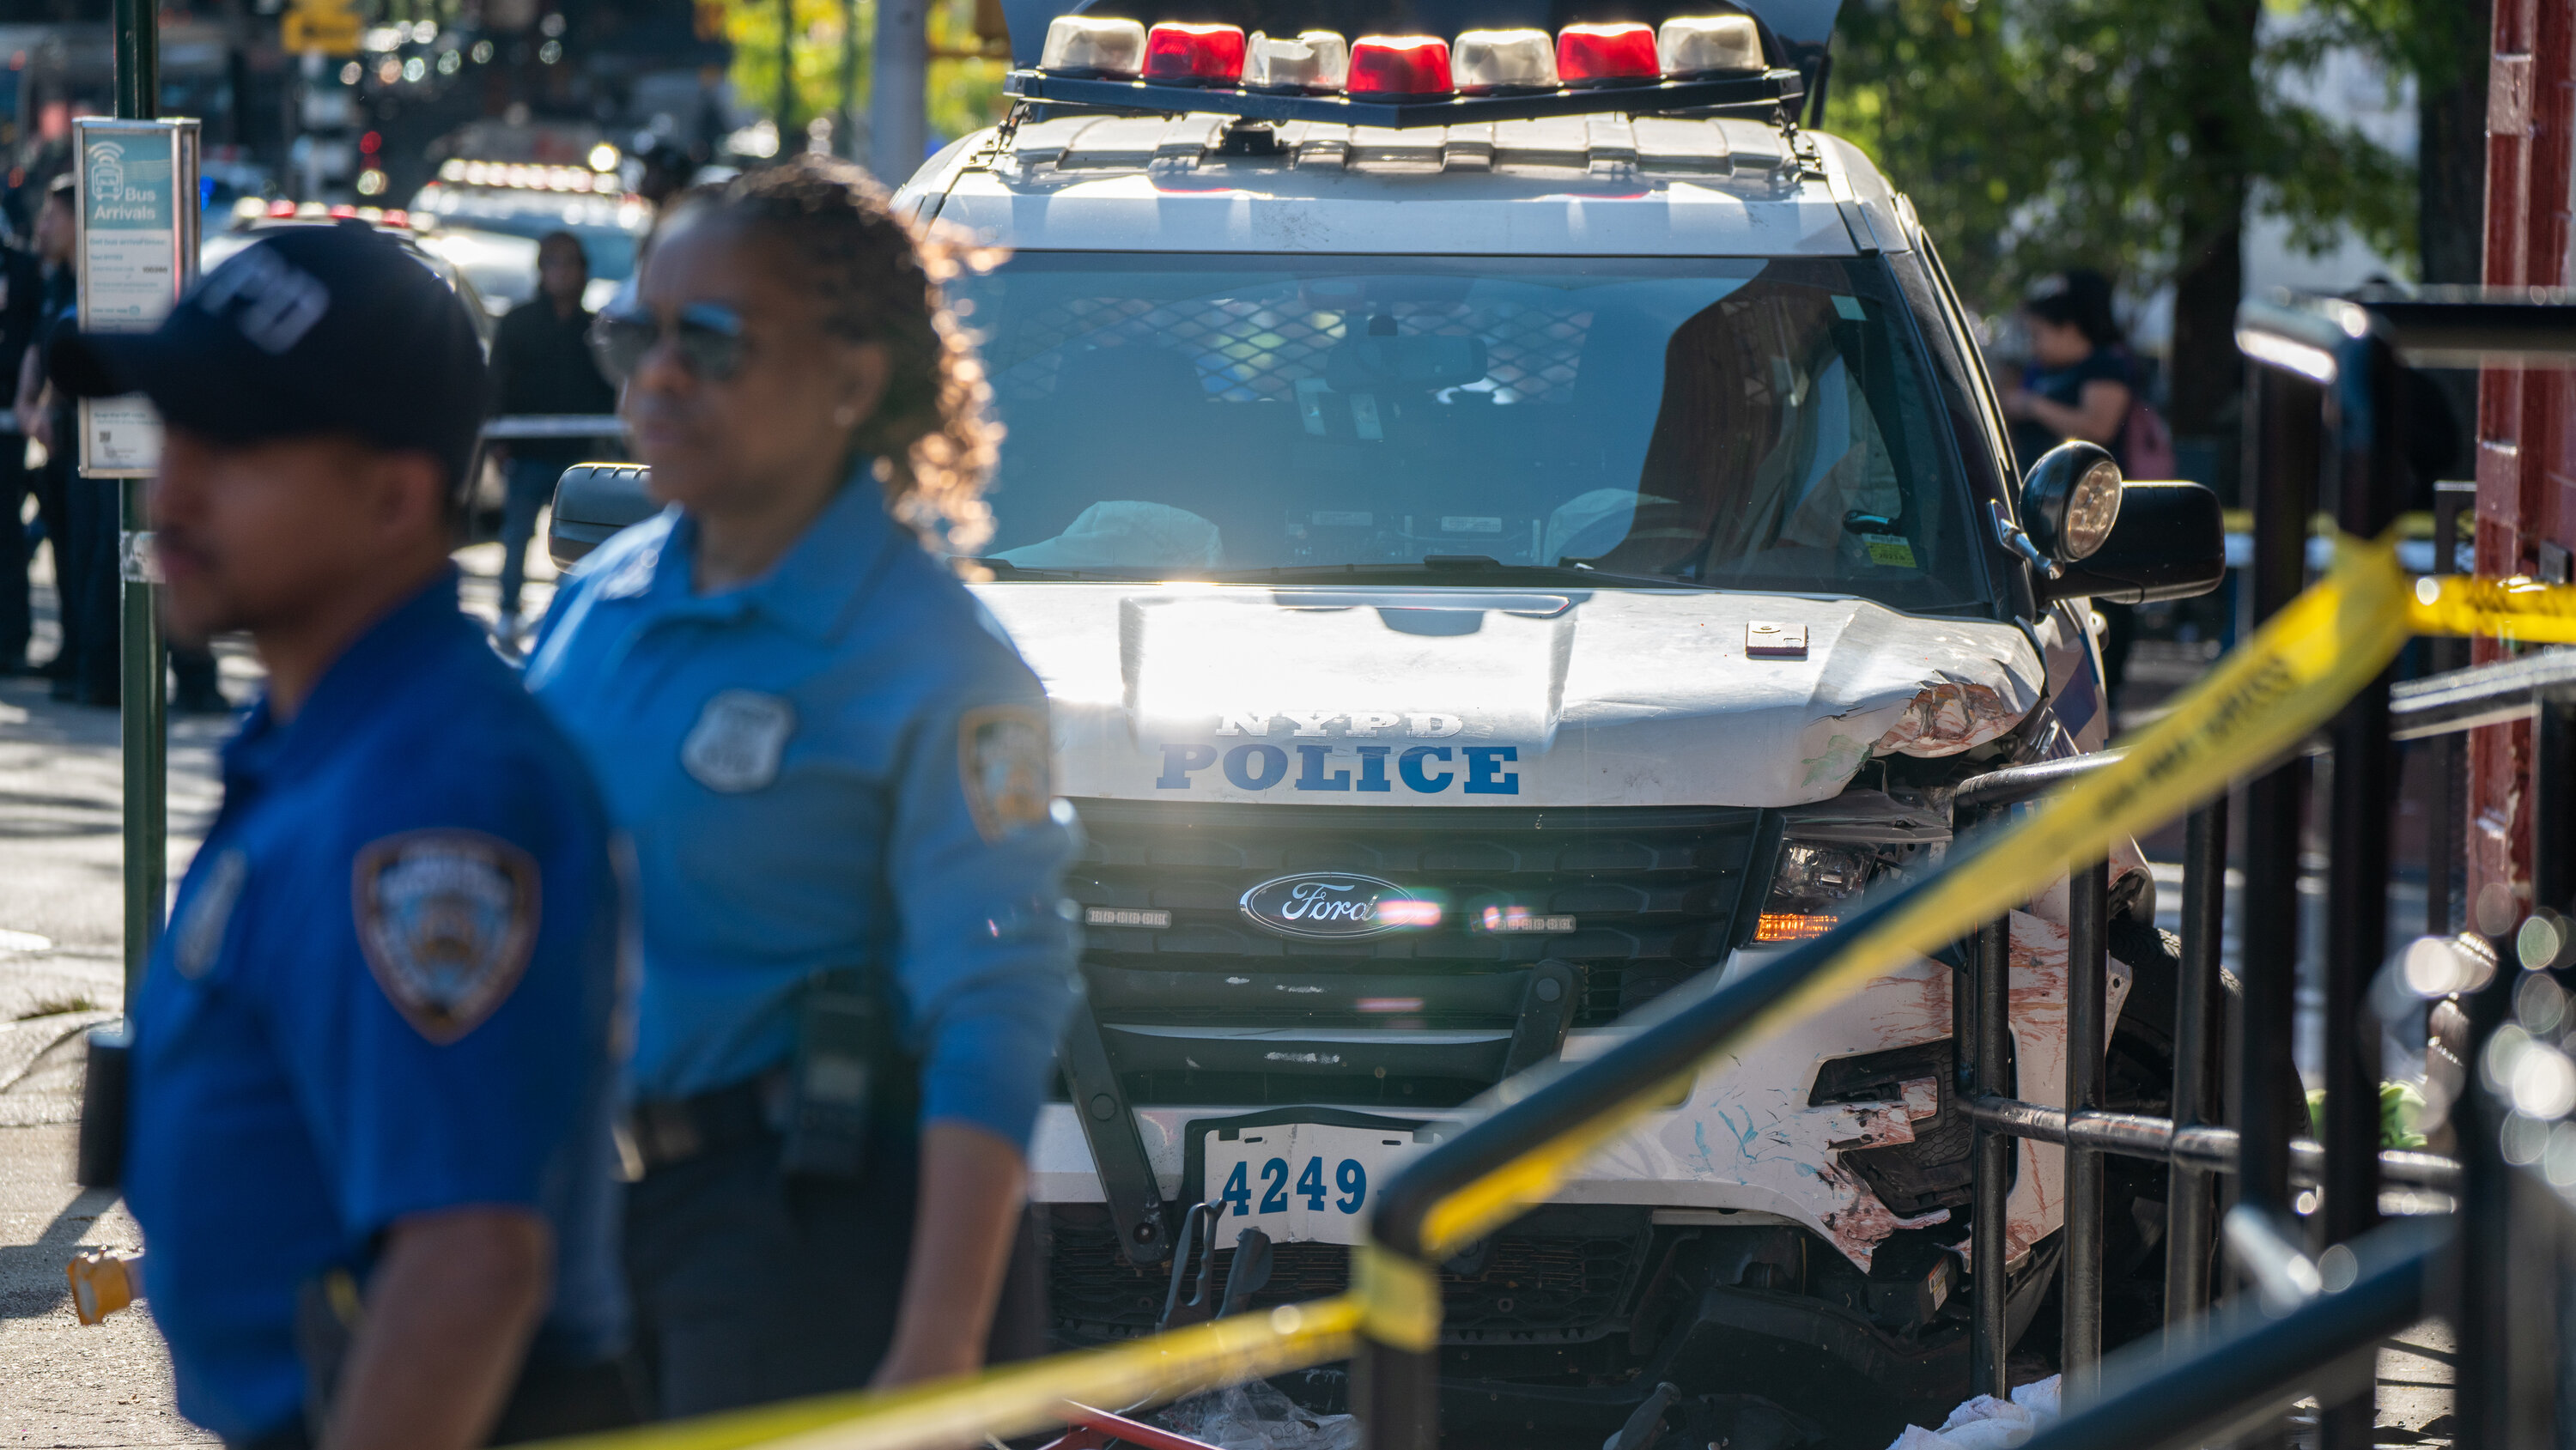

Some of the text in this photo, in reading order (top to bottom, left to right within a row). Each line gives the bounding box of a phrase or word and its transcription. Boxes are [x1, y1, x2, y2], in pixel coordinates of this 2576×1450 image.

[125, 186, 156, 202] Bus
[94, 204, 156, 221] Arrivals
[1215, 710, 1463, 738] NYPD
[1155, 743, 1520, 796] POLICE
[1281, 882, 1380, 922] Ford
[1222, 1156, 1367, 1216] 4249
